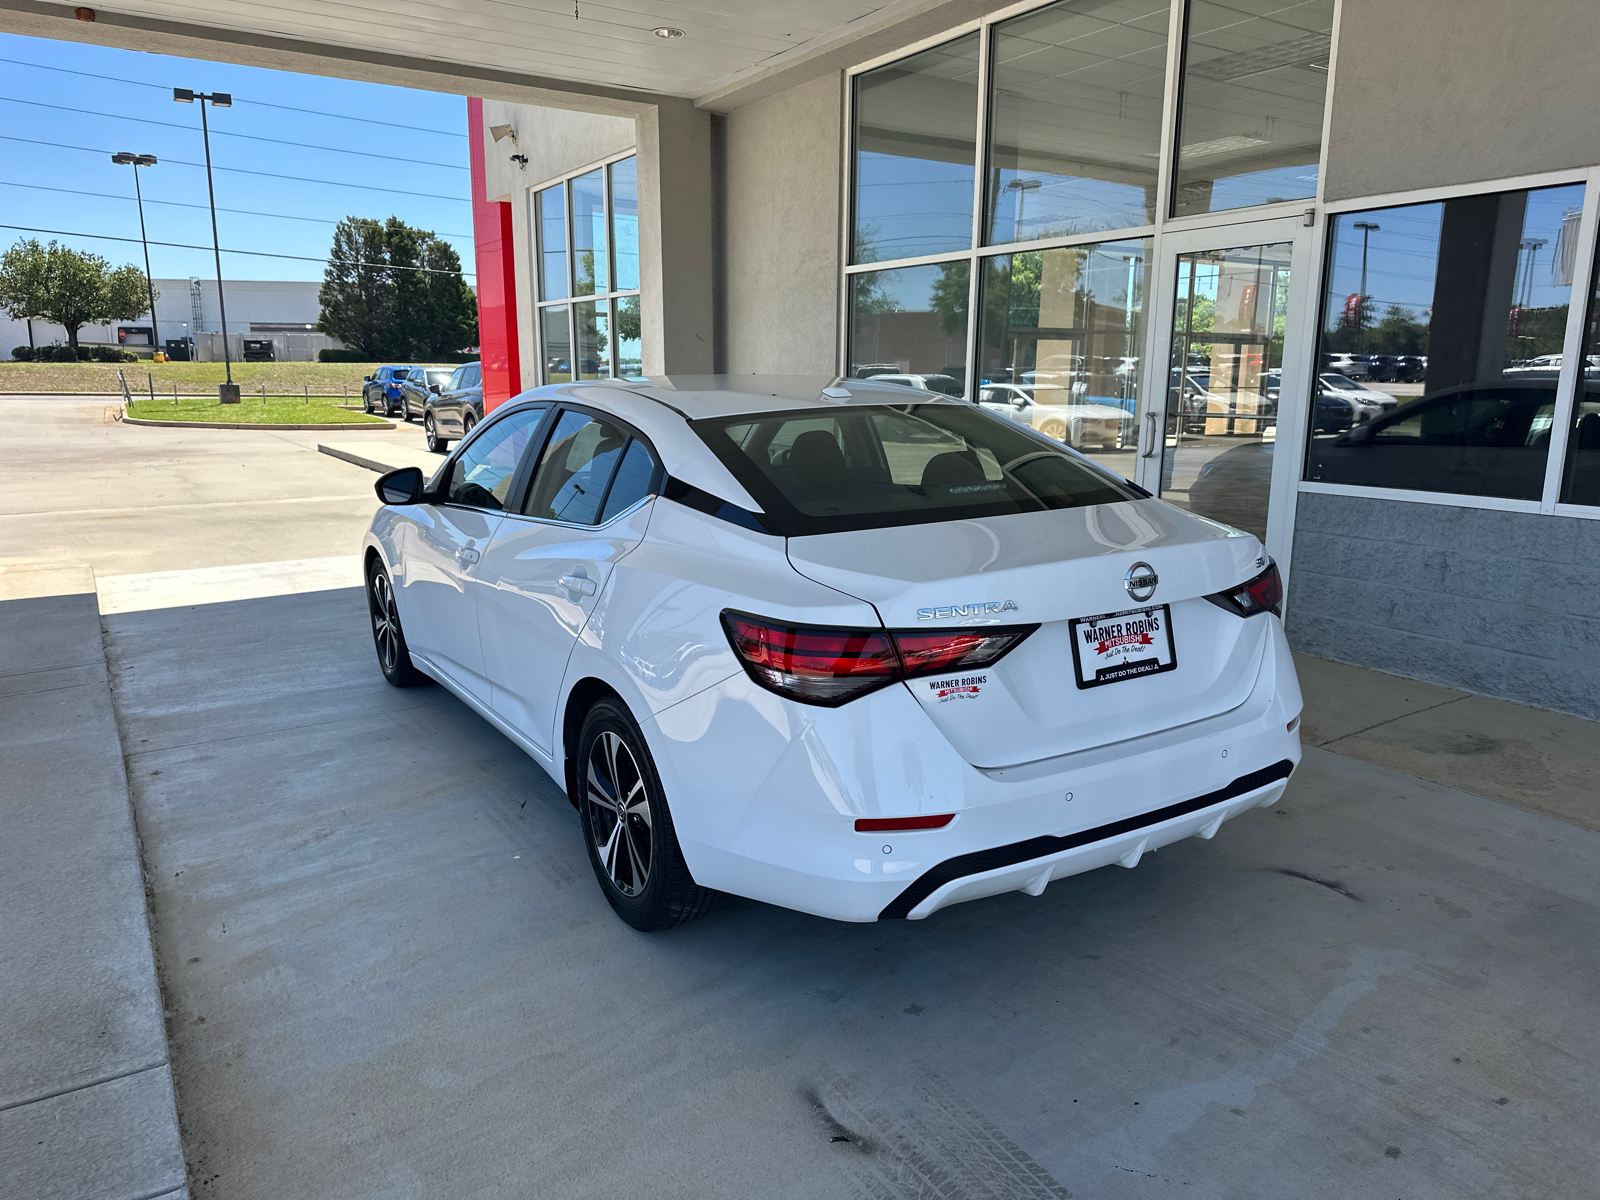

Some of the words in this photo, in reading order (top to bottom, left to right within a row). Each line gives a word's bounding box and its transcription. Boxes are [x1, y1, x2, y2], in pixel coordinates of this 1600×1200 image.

[1129, 575, 1157, 587] NISSAN
[917, 600, 1019, 620] SENTRA
[1083, 622, 1123, 644] WARNER
[1125, 617, 1160, 635] ROBINS
[1104, 634, 1143, 649] MITSUBISHI
[1105, 649, 1114, 660] Just
[1114, 647, 1121, 656] Do
[1121, 646, 1130, 654] The
[1130, 645, 1146, 653] Deal!
[1104, 672, 1118, 680] JUST
[1137, 664, 1154, 673] DEAL!
[929, 679, 960, 690] WARNER
[961, 675, 987, 686] ROBINS
